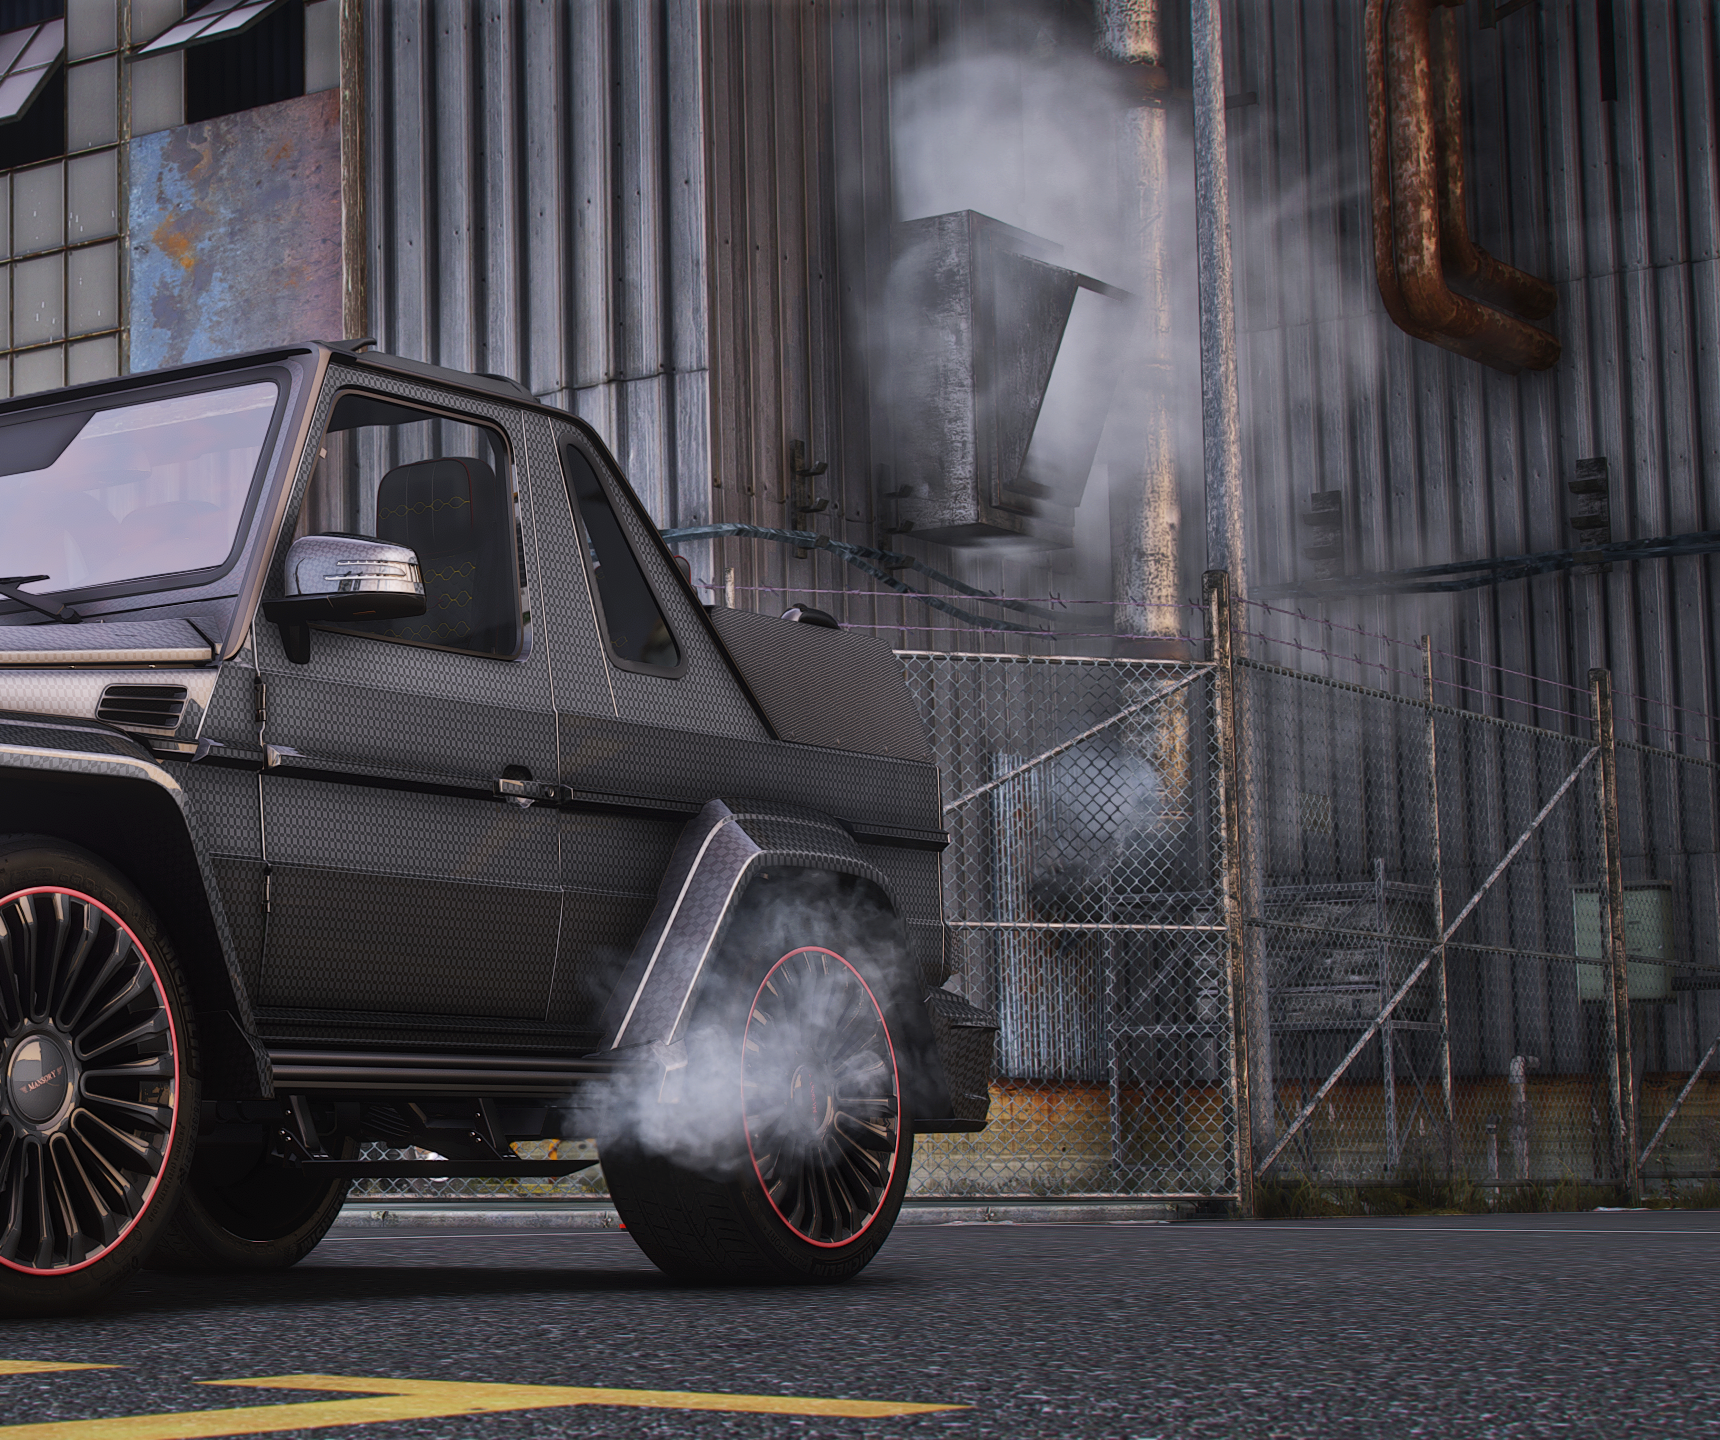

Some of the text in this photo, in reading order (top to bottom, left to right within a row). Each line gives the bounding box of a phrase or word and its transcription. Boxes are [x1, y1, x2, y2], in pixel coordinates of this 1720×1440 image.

[159, 935, 201, 1073] MICHELIN
[27, 1069, 57, 1092] MANSORY
[767, 1229, 789, 1255] SPORT
[812, 1244, 874, 1277] MICHELIN
